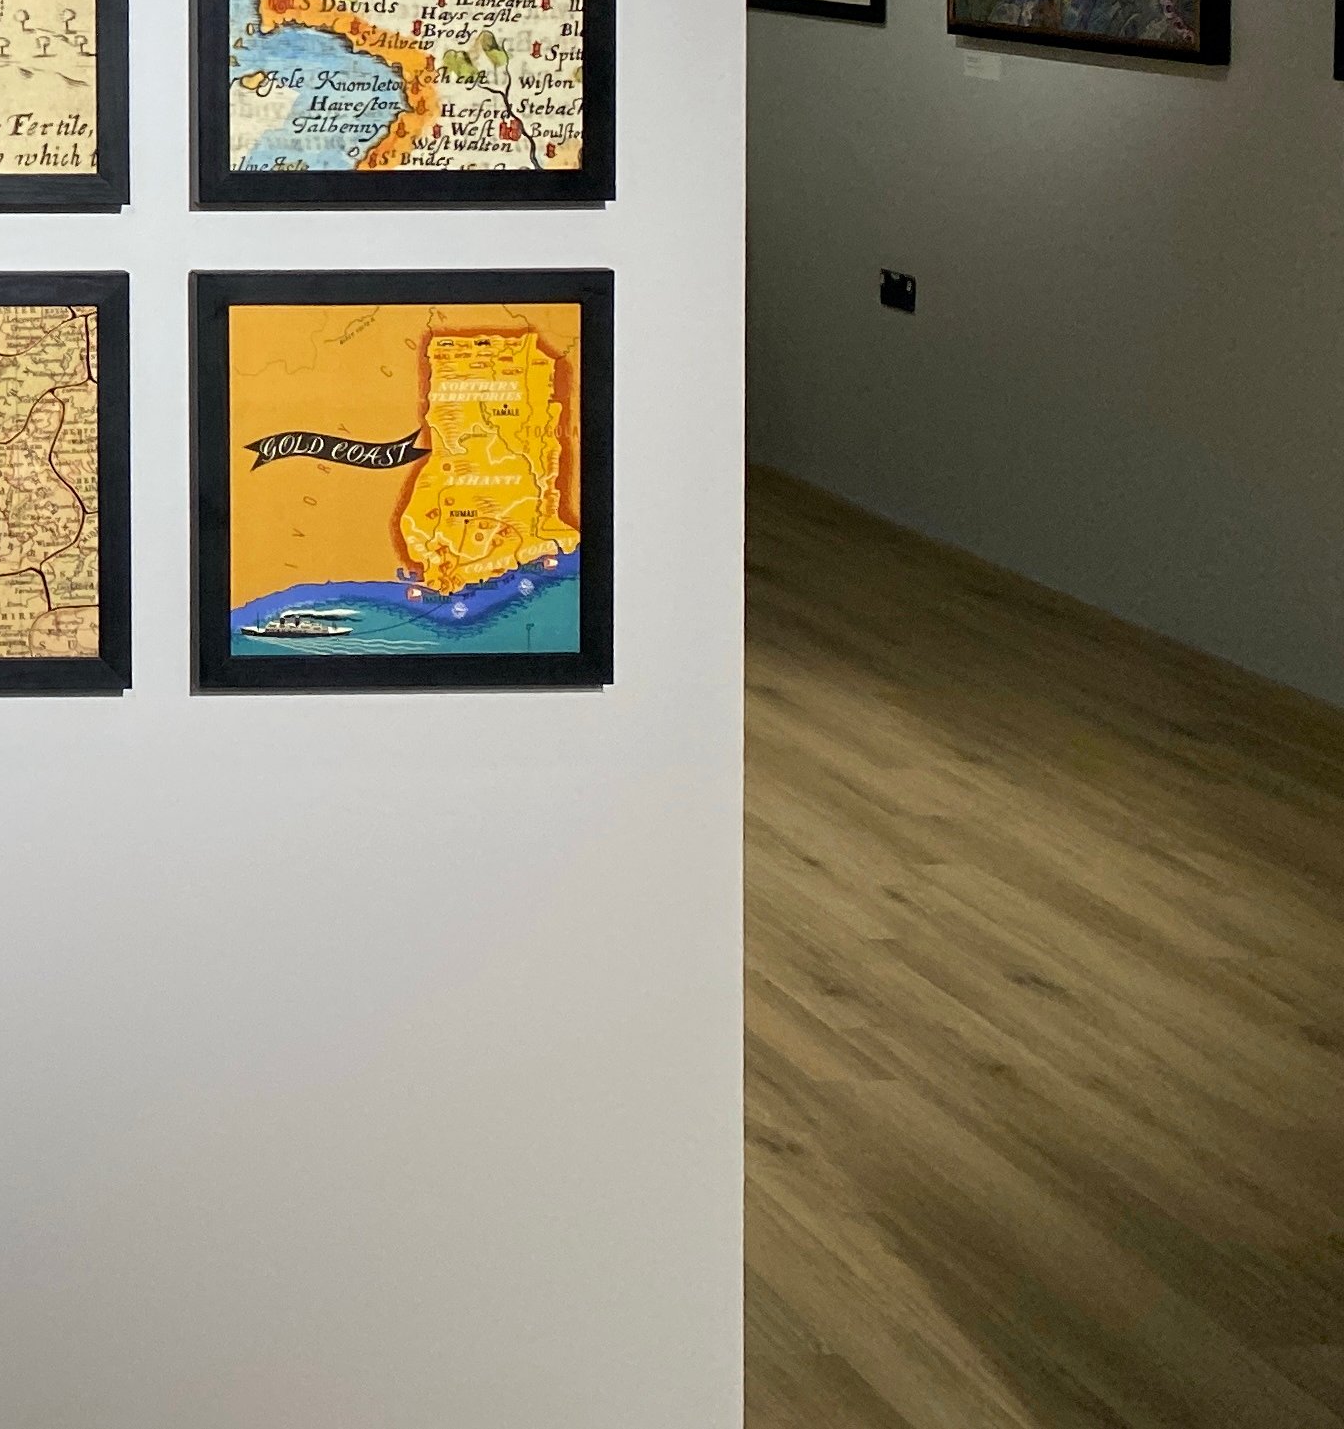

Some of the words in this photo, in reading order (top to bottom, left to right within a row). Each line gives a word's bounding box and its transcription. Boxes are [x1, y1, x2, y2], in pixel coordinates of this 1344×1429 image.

[422, 22, 478, 45] Brody
[15, 142, 82, 168] which
[258, 433, 324, 462] GOLD
[330, 439, 414, 467] COAST
